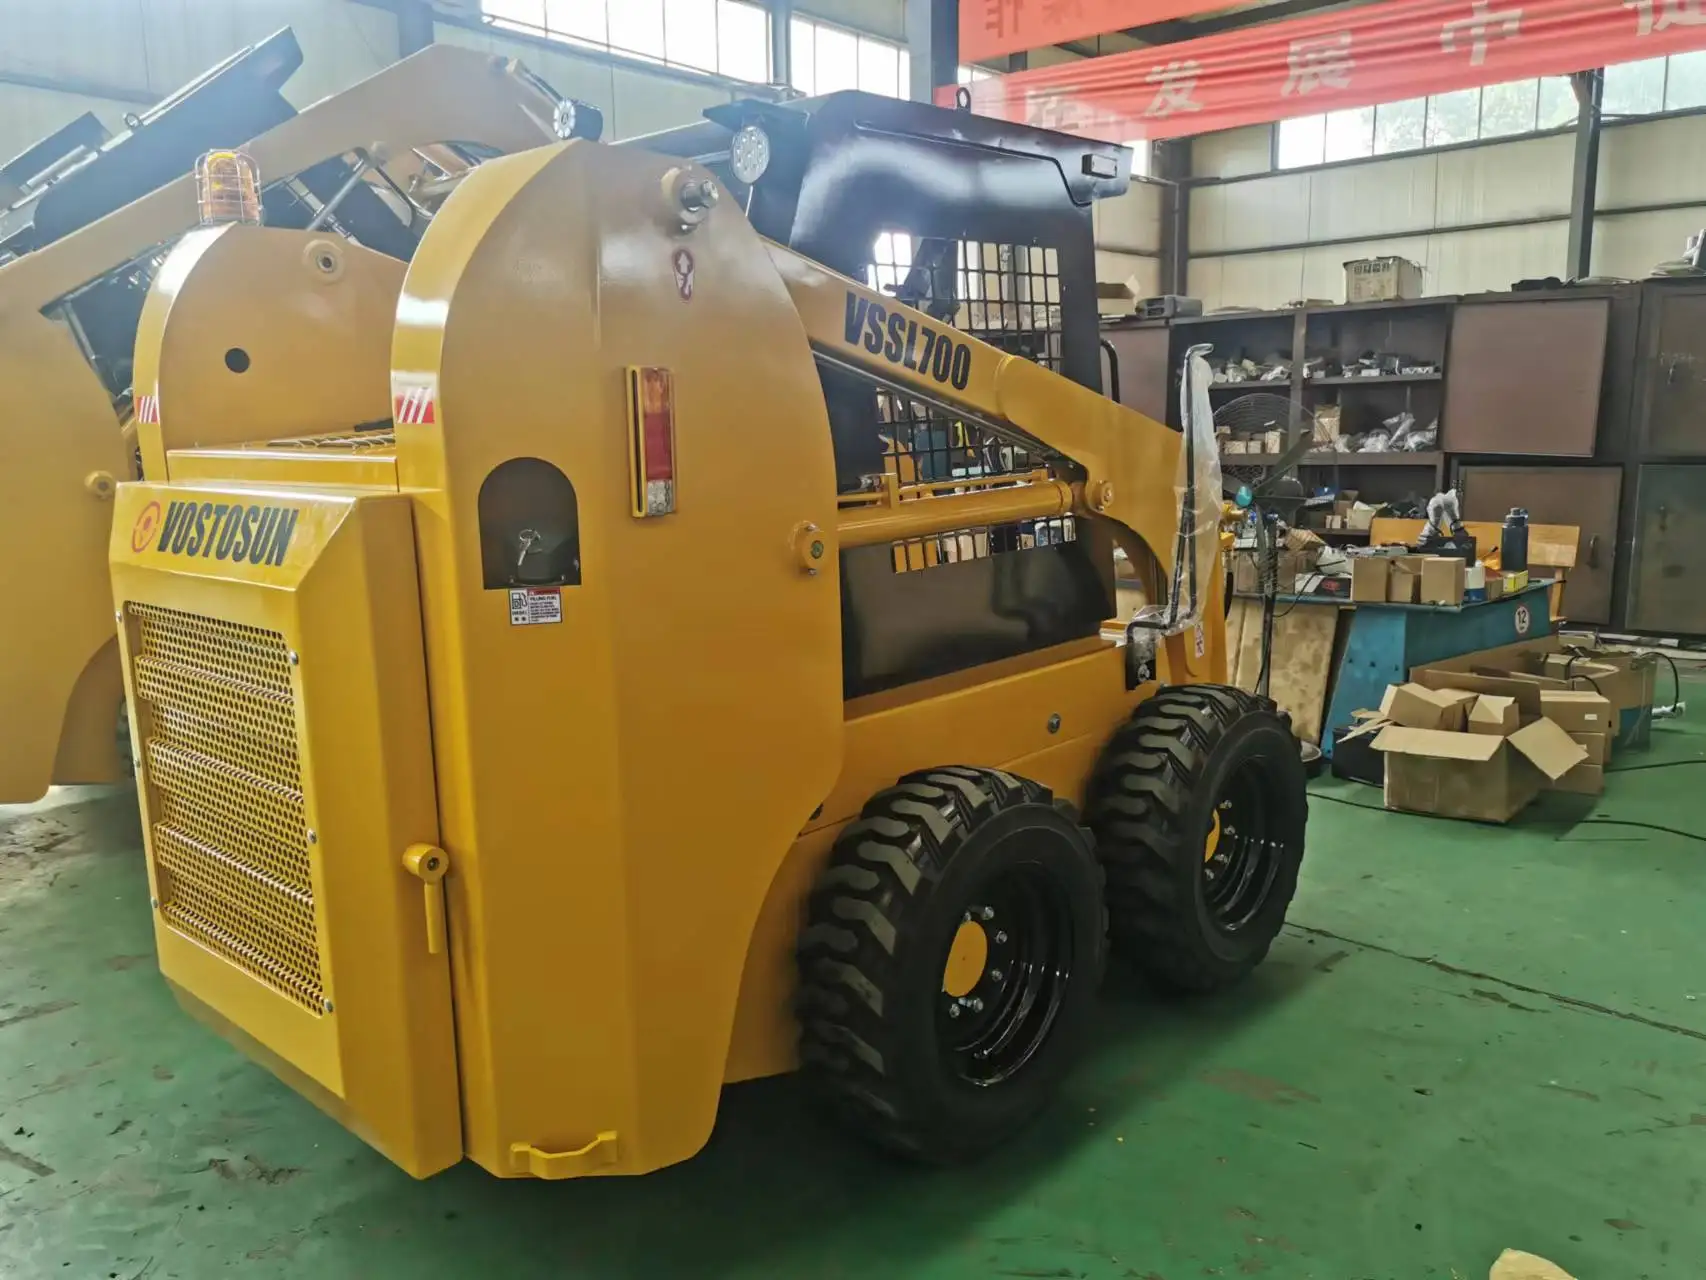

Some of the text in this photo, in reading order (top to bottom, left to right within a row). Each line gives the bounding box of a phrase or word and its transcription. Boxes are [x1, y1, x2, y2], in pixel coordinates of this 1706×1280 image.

[844, 291, 971, 391] VSSL700
[157, 501, 299, 566] VOSTOSUN
[1517, 609, 1527, 624] 12
